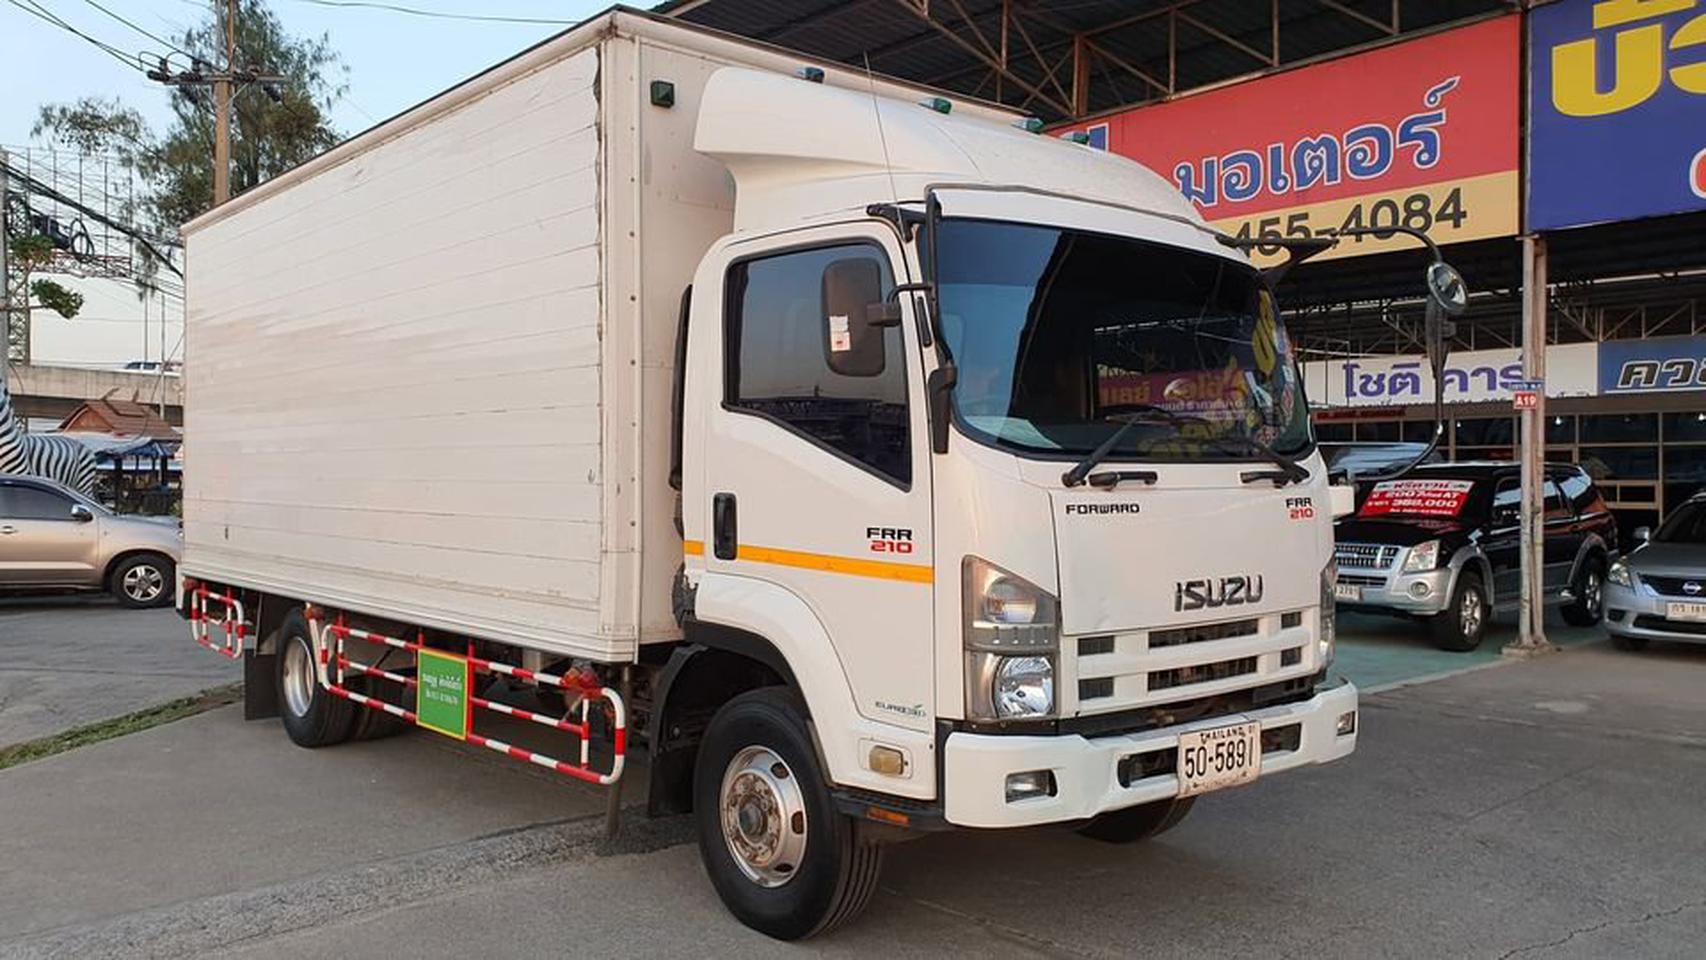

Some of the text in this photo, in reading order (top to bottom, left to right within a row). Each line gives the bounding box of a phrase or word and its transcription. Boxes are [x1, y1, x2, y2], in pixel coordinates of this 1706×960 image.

[1174, 76, 1461, 207] มอเตอร์
[1342, 353, 1523, 398] โชติ คาร
[1066, 502, 1140, 515] FORWARD
[1285, 497, 1312, 509] FRR
[1290, 508, 1314, 519] 210
[866, 527, 912, 540] FRR
[870, 540, 912, 554] 210
[1174, 574, 1263, 612] ISUZU
[1185, 735, 1254, 779] 50-5891
